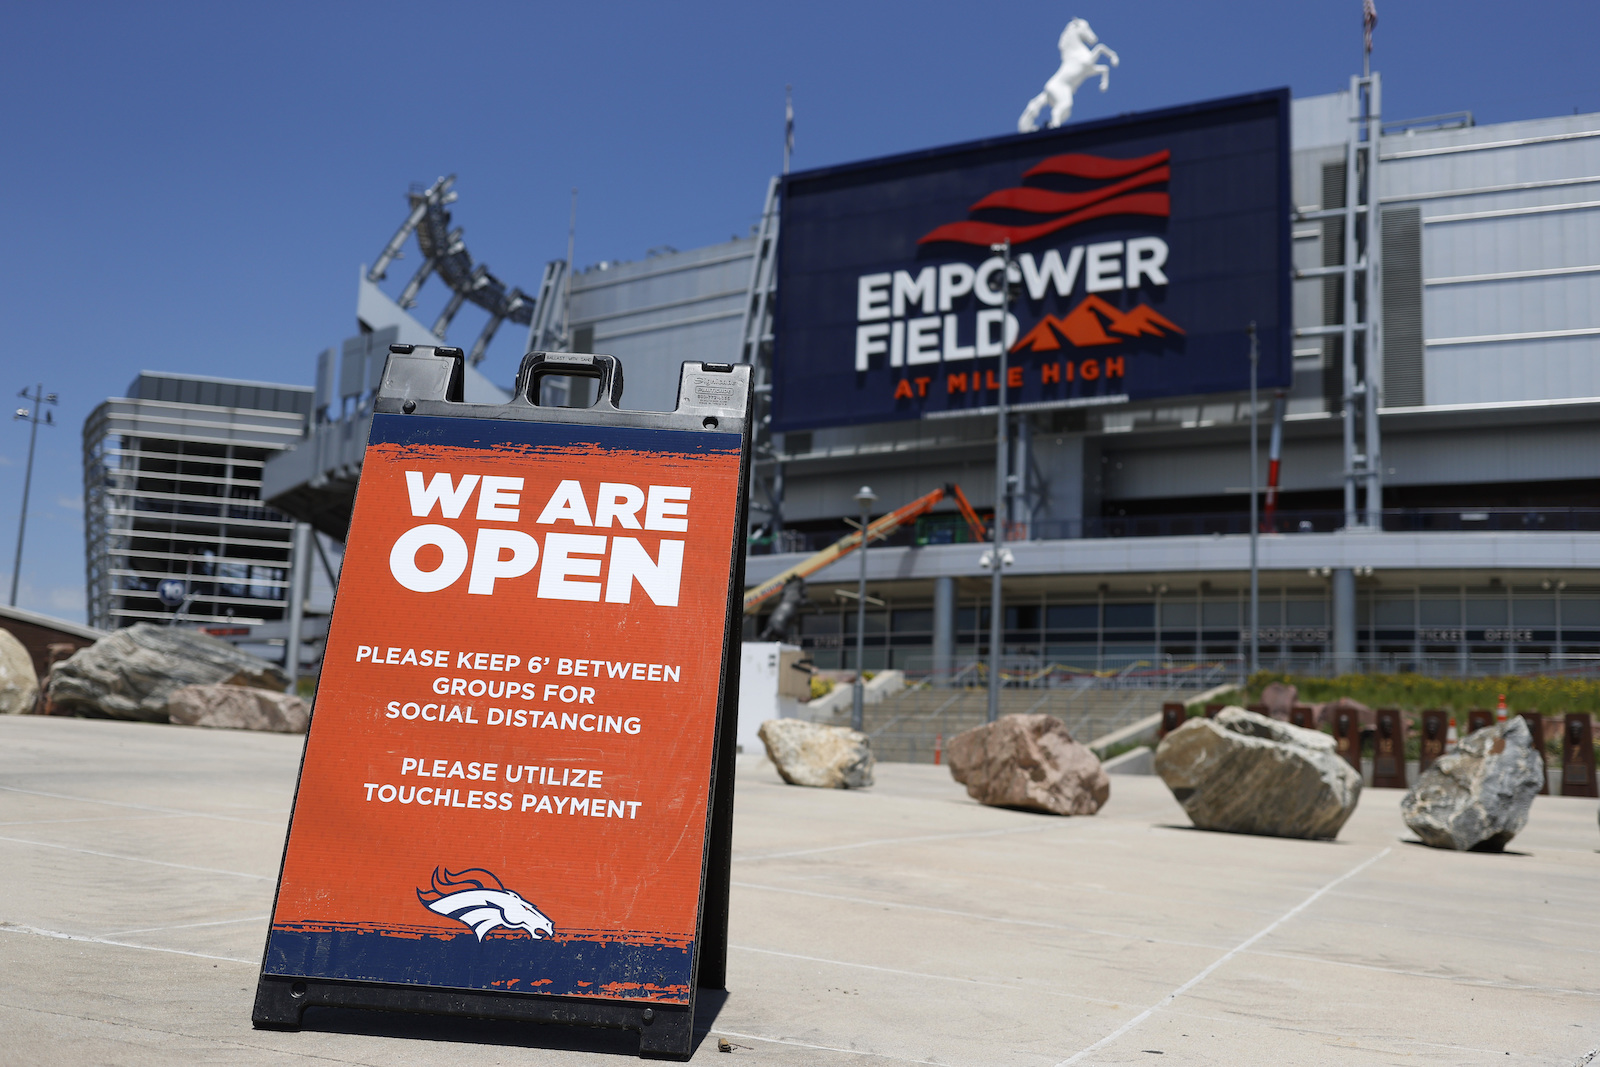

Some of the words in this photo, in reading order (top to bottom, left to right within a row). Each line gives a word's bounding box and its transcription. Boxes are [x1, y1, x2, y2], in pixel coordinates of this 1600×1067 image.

[857, 236, 1169, 322] EMPOWER
[854, 309, 1020, 372] FIELD
[894, 377, 931, 399] AT
[947, 366, 1025, 394] MILE
[1041, 356, 1125, 385] HIGH
[404, 470, 525, 523] WE
[535, 479, 693, 533] ARE
[388, 523, 686, 608] OPEN
[355, 644, 450, 668] PLEASE
[456, 651, 521, 672] KEEP
[556, 657, 682, 683] BETWEEN
[432, 676, 536, 701] GROUPS
[542, 683, 596, 705] FOR
[385, 700, 479, 725] SOCIAL
[486, 707, 642, 735] DISTANCING
[400, 757, 499, 782] PLEASE
[505, 764, 604, 789] UTILIZE
[363, 782, 514, 812] TOUCHLESS
[520, 793, 643, 820] PAYMENT
